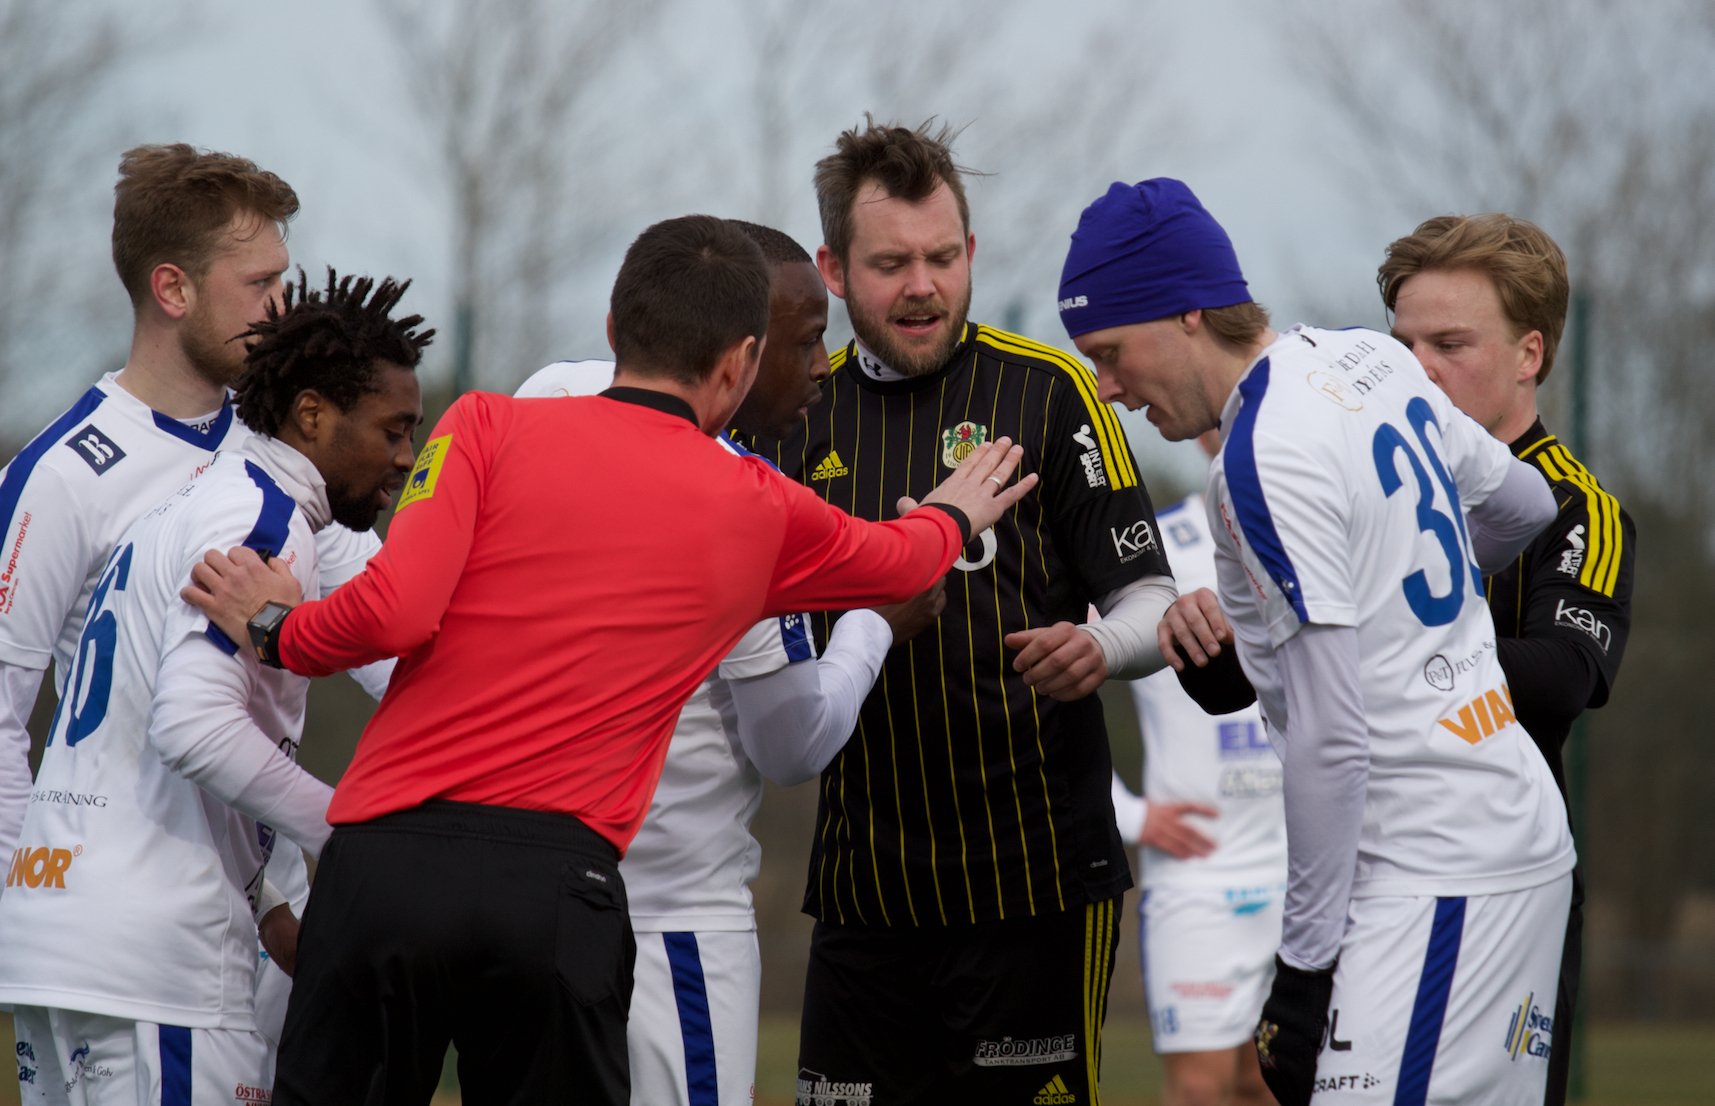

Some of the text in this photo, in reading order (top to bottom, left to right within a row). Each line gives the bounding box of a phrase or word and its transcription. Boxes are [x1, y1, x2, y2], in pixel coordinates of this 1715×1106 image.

[811, 466, 849, 482] adidas
[1080, 452, 1099, 488] SPORT
[1088, 448, 1105, 487] INTER
[1, 511, 32, 583] Supermarket
[1555, 598, 1612, 652] kan
[975, 1033, 1076, 1058] FRÖDINGE
[984, 1053, 1066, 1066] TANKTRANSPORT AB
[235, 1083, 267, 1100] ÖSTRA
[814, 1081, 873, 1097] NILSSONS
[1033, 1093, 1076, 1106] adidas
